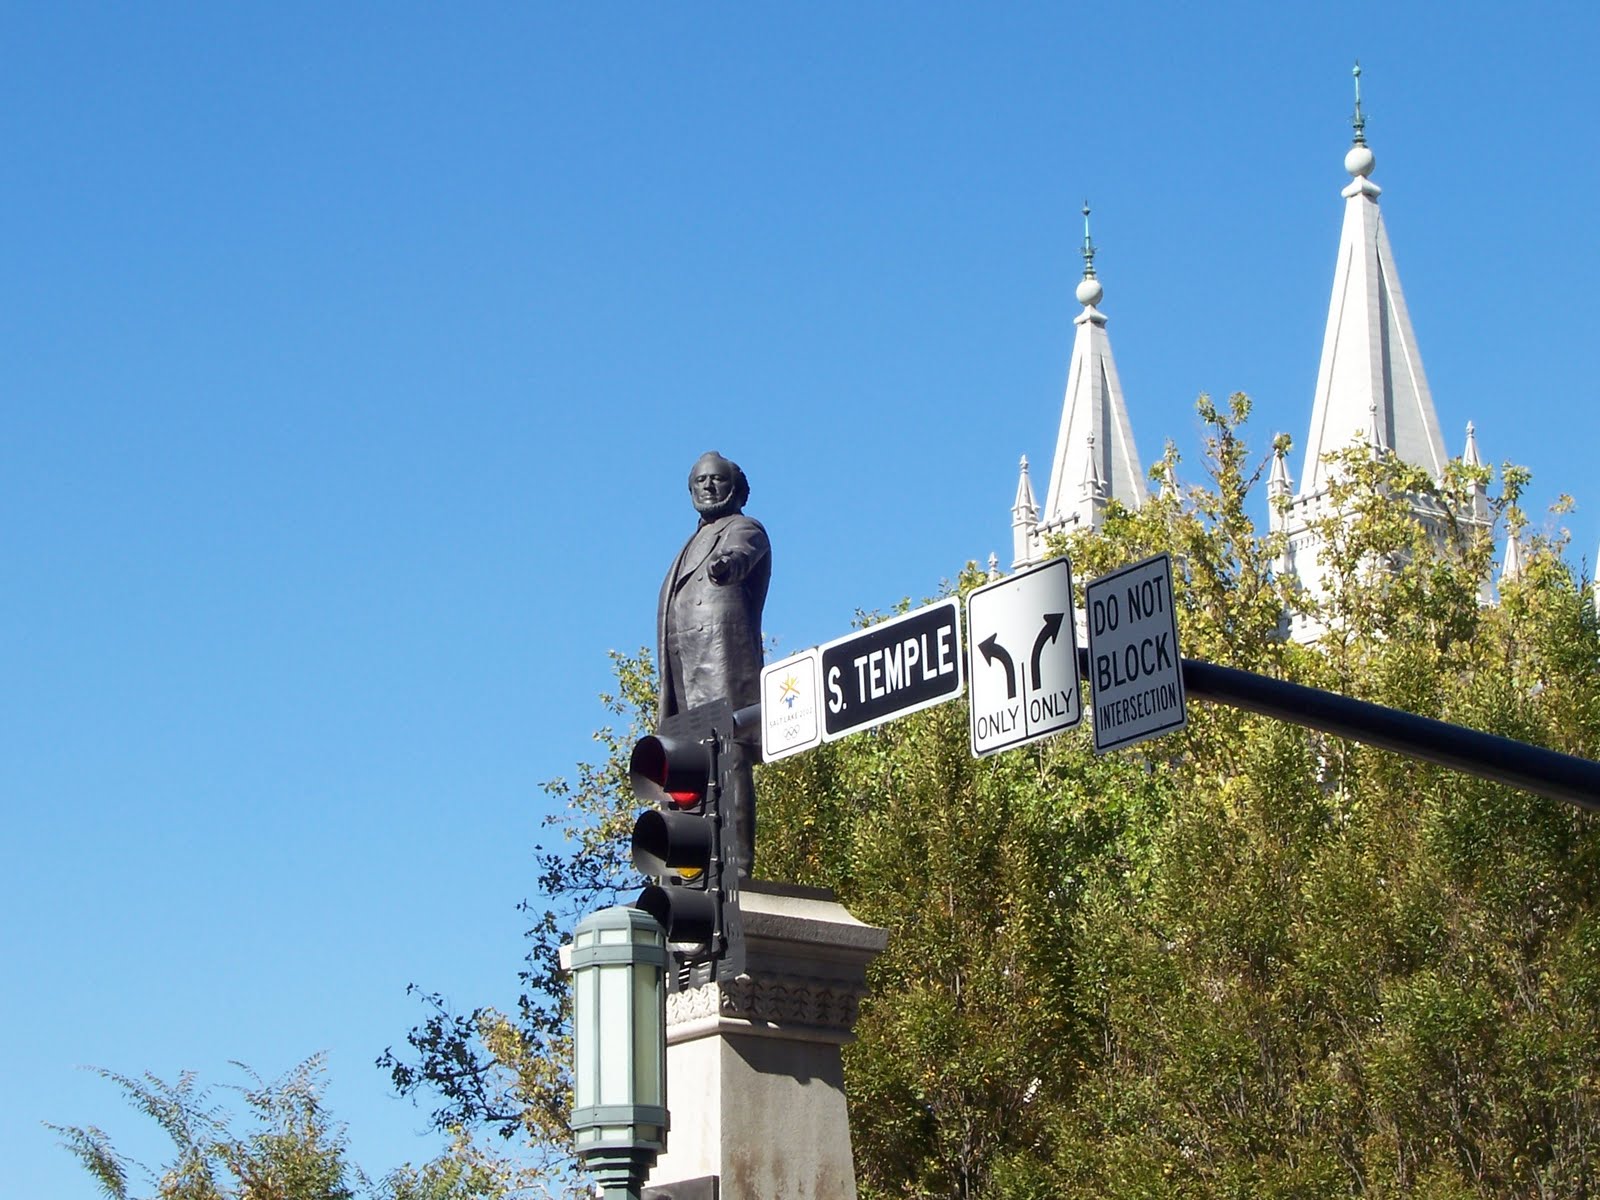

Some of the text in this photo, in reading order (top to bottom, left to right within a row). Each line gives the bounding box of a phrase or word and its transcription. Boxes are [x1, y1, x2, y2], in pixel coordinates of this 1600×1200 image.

[1093, 575, 1164, 636] DO NOT
[828, 624, 954, 714] S. TEMPLE
[1096, 631, 1172, 692] BLOCK
[977, 705, 1019, 740] ONLY
[1030, 687, 1073, 723] ONLY
[1099, 682, 1177, 731] INTERSECTION
